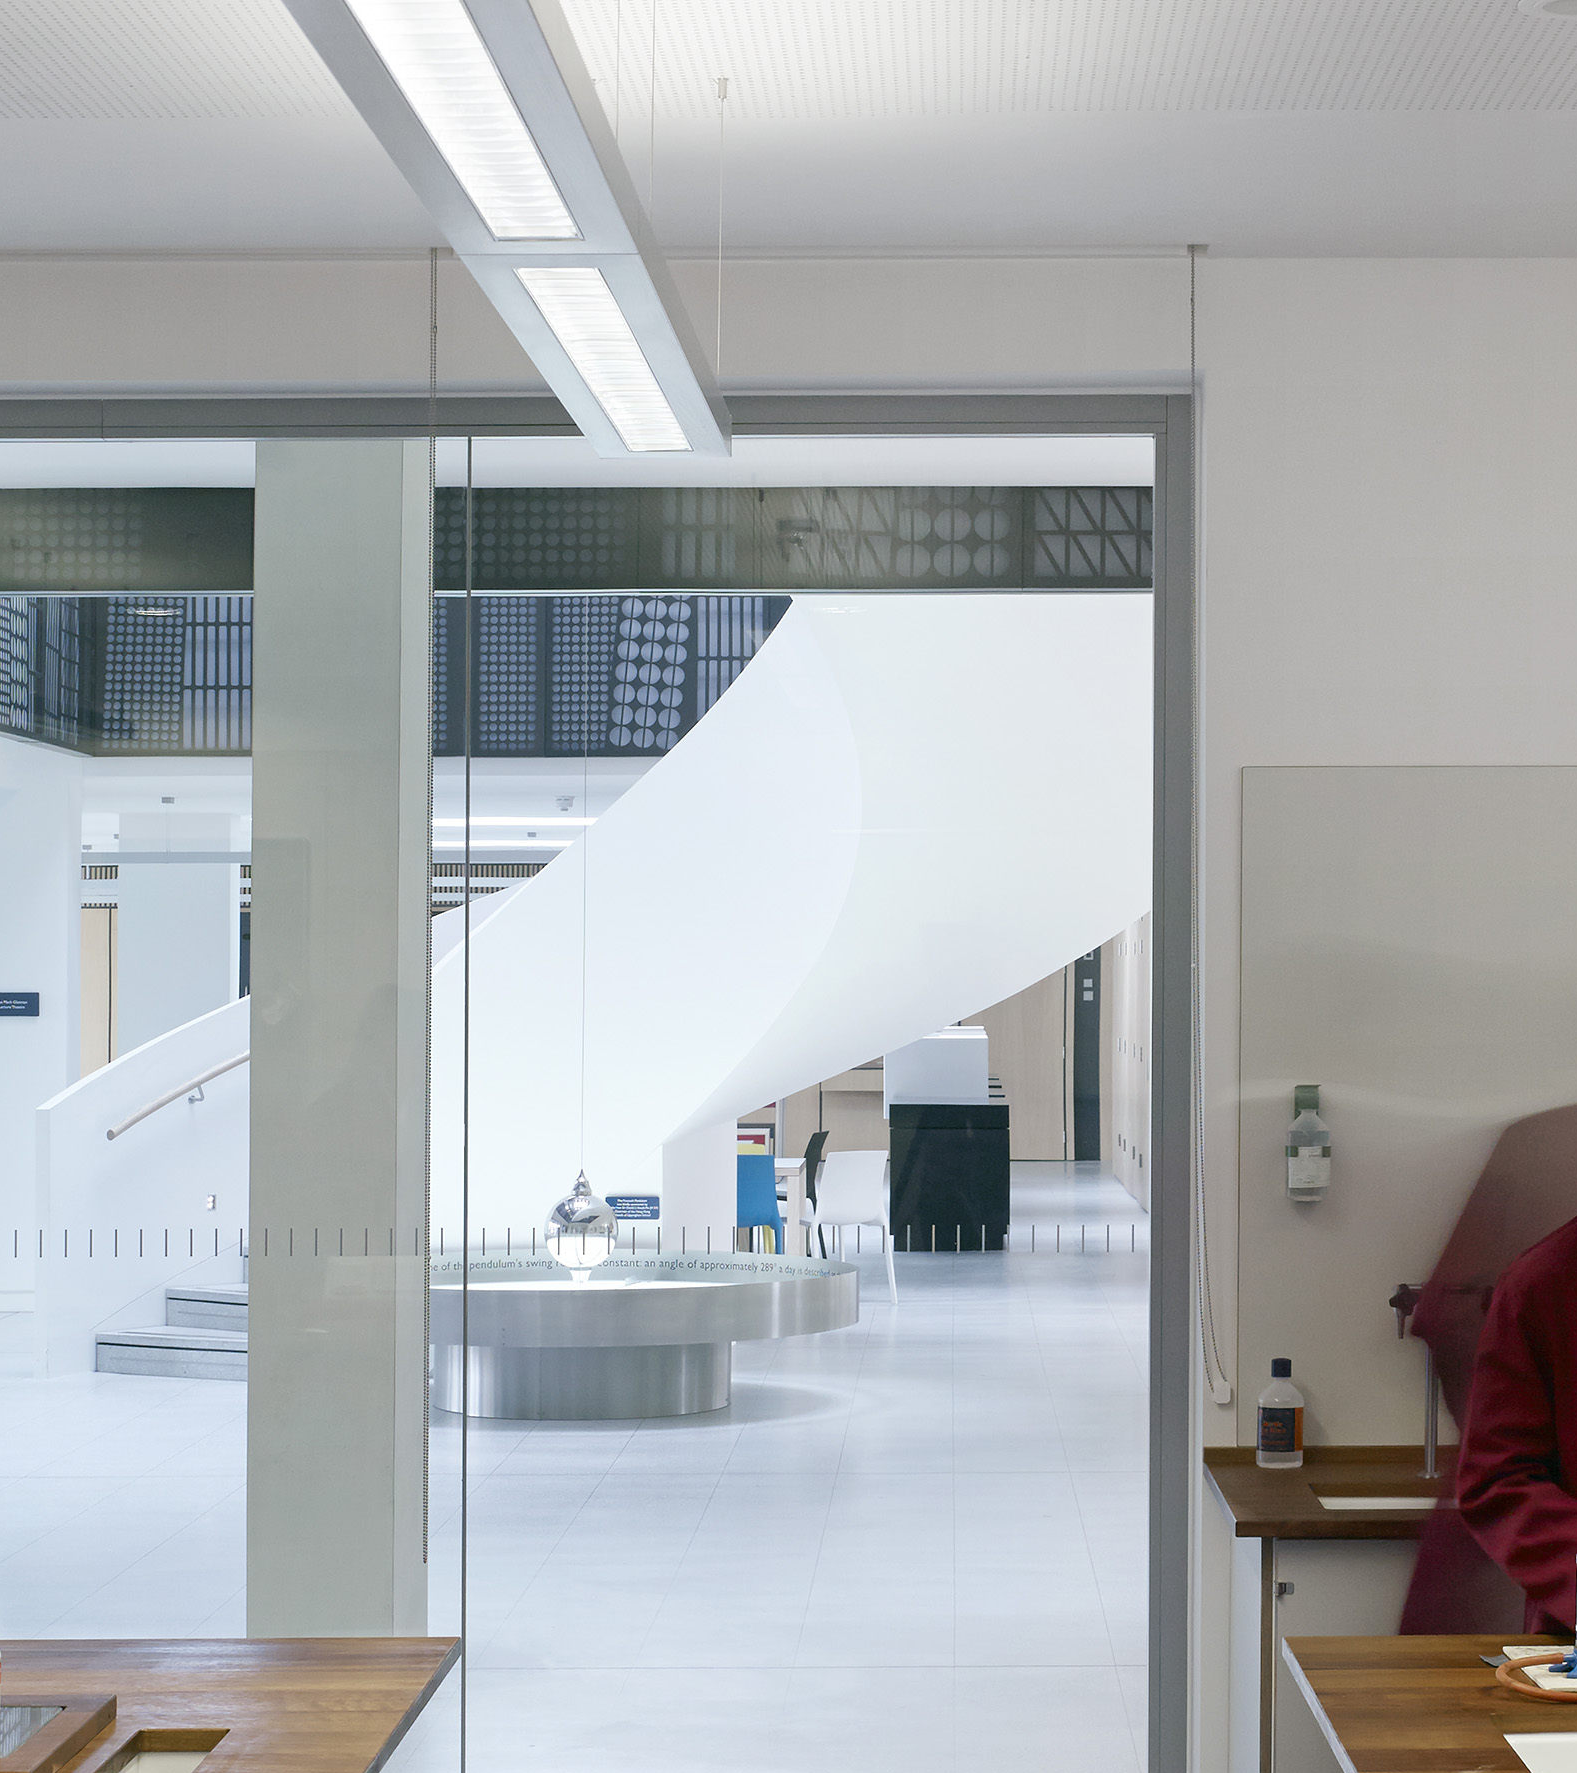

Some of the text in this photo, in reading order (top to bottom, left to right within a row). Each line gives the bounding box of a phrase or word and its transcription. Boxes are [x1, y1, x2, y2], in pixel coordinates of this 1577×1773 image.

[441, 1262, 451, 1271] of
[469, 1259, 522, 1272] pendulum's
[526, 1259, 553, 1270] swing
[644, 1260, 656, 1268] an
[659, 1259, 684, 1271] angle
[687, 1259, 697, 1269] of
[700, 1261, 758, 1273] approximately
[785, 1265, 796, 1276] day
